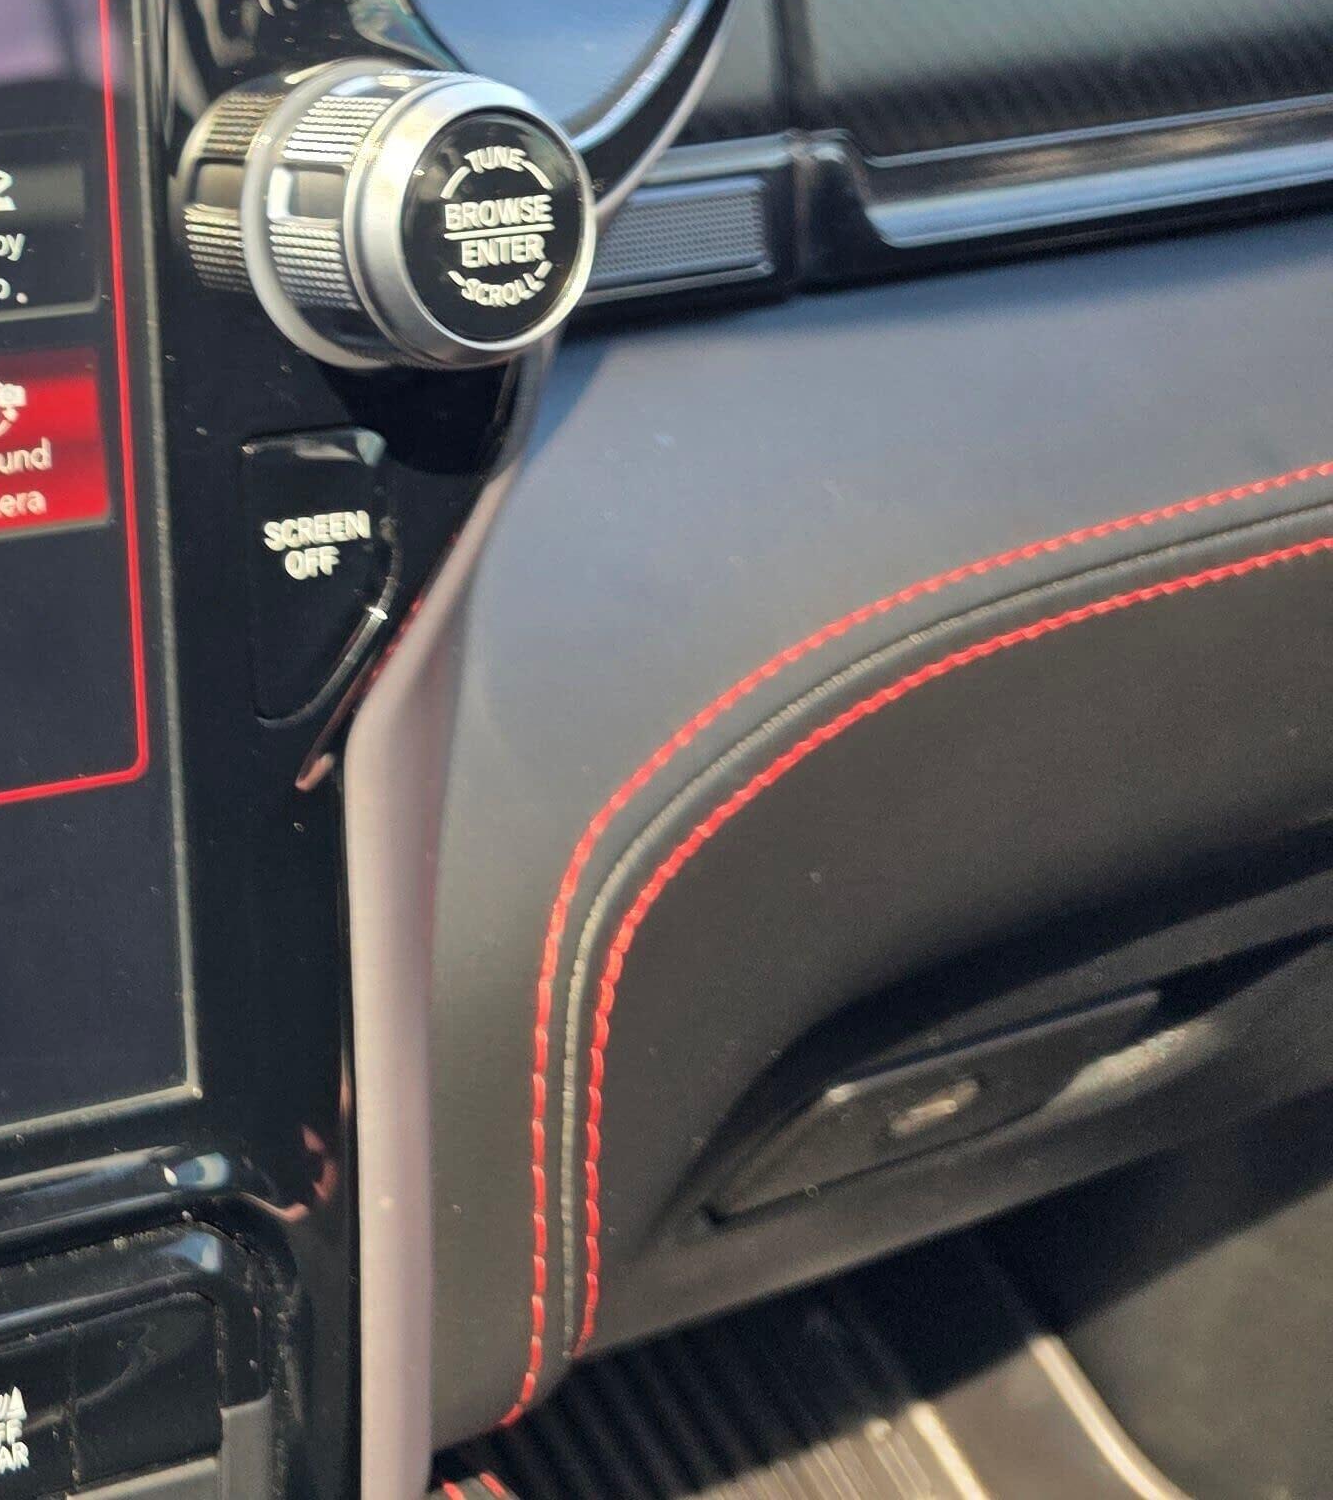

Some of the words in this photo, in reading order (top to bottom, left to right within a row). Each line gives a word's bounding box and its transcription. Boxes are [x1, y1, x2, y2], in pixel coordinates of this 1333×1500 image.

[464, 145, 528, 174] TUNE
[444, 194, 554, 231] BROWSE
[461, 233, 547, 268] ENTER
[461, 272, 546, 307] SCROLL
[263, 510, 372, 552] SCREEN
[284, 545, 341, 581] OFF
